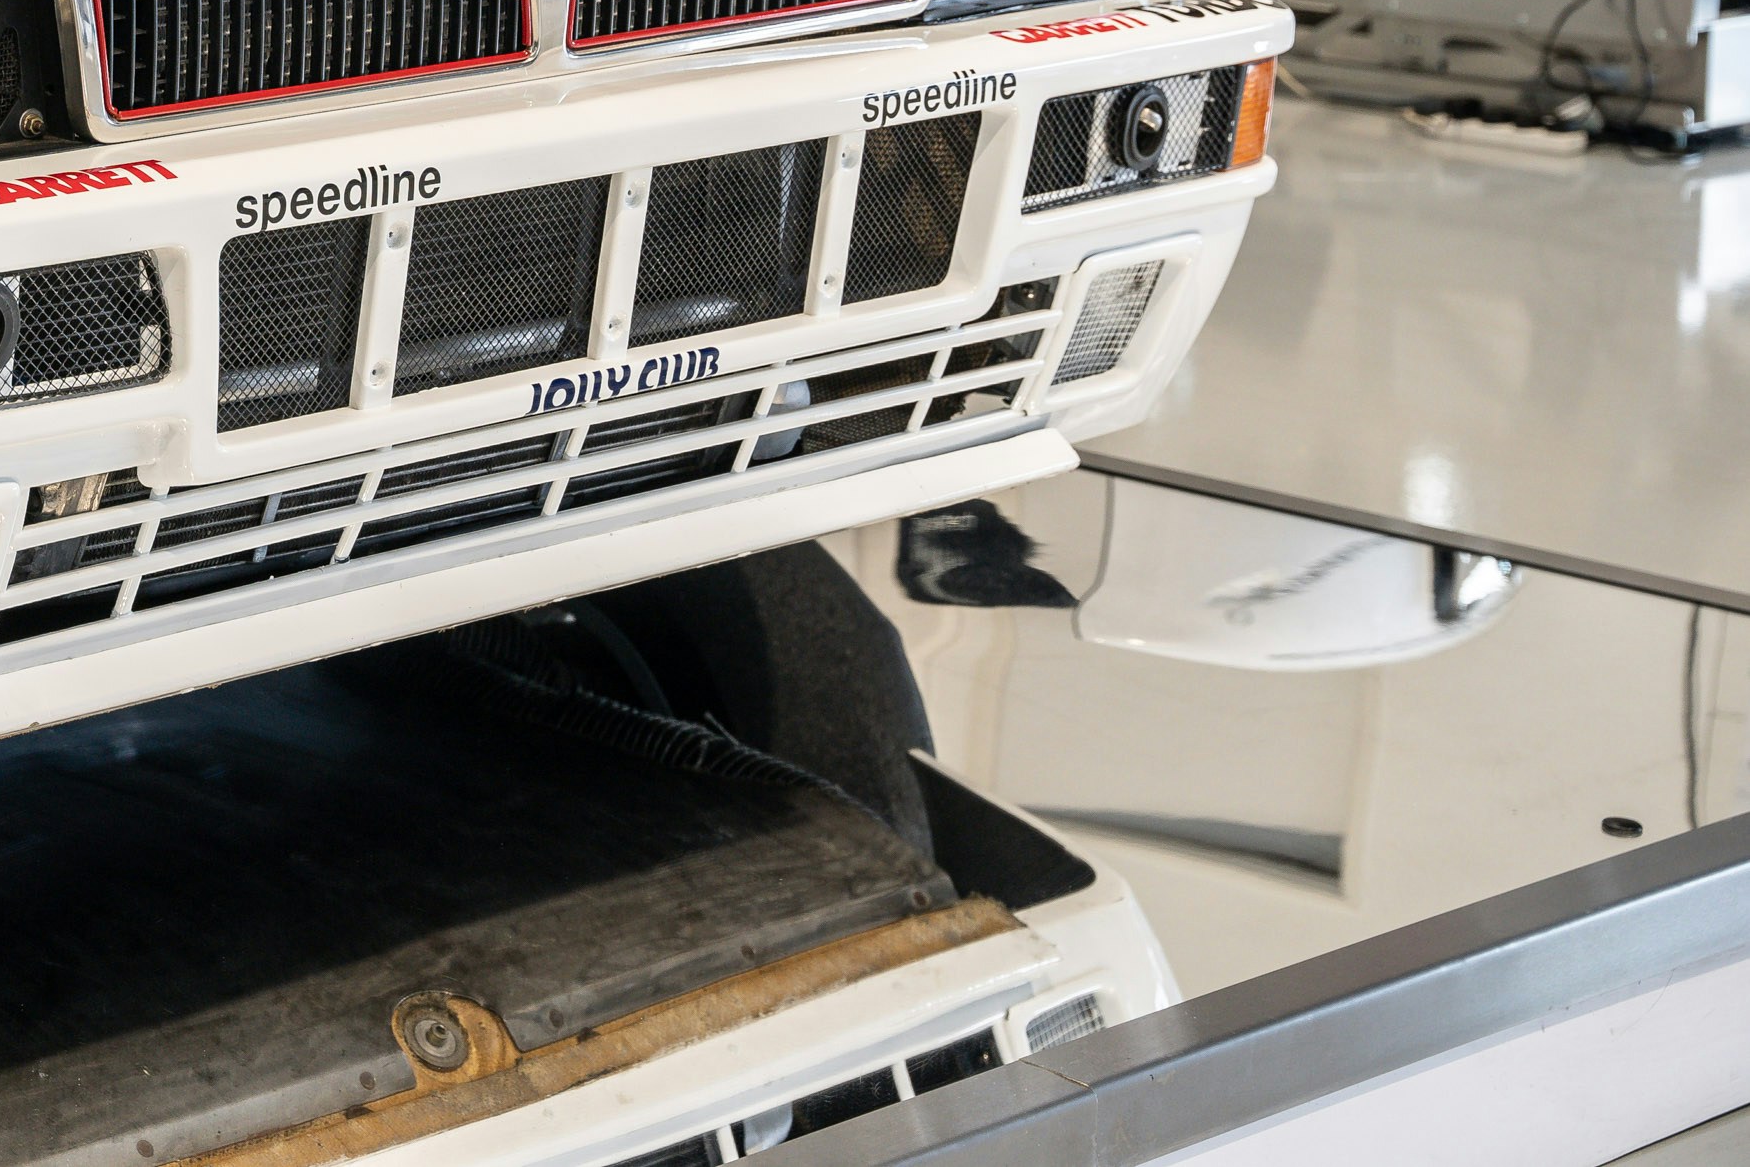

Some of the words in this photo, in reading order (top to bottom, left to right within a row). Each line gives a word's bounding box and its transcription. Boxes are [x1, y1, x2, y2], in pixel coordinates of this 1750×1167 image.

[861, 70, 1018, 127] speedline
[235, 164, 442, 231] speedline
[525, 364, 631, 416] JOLLY
[637, 346, 721, 392] CLUB
